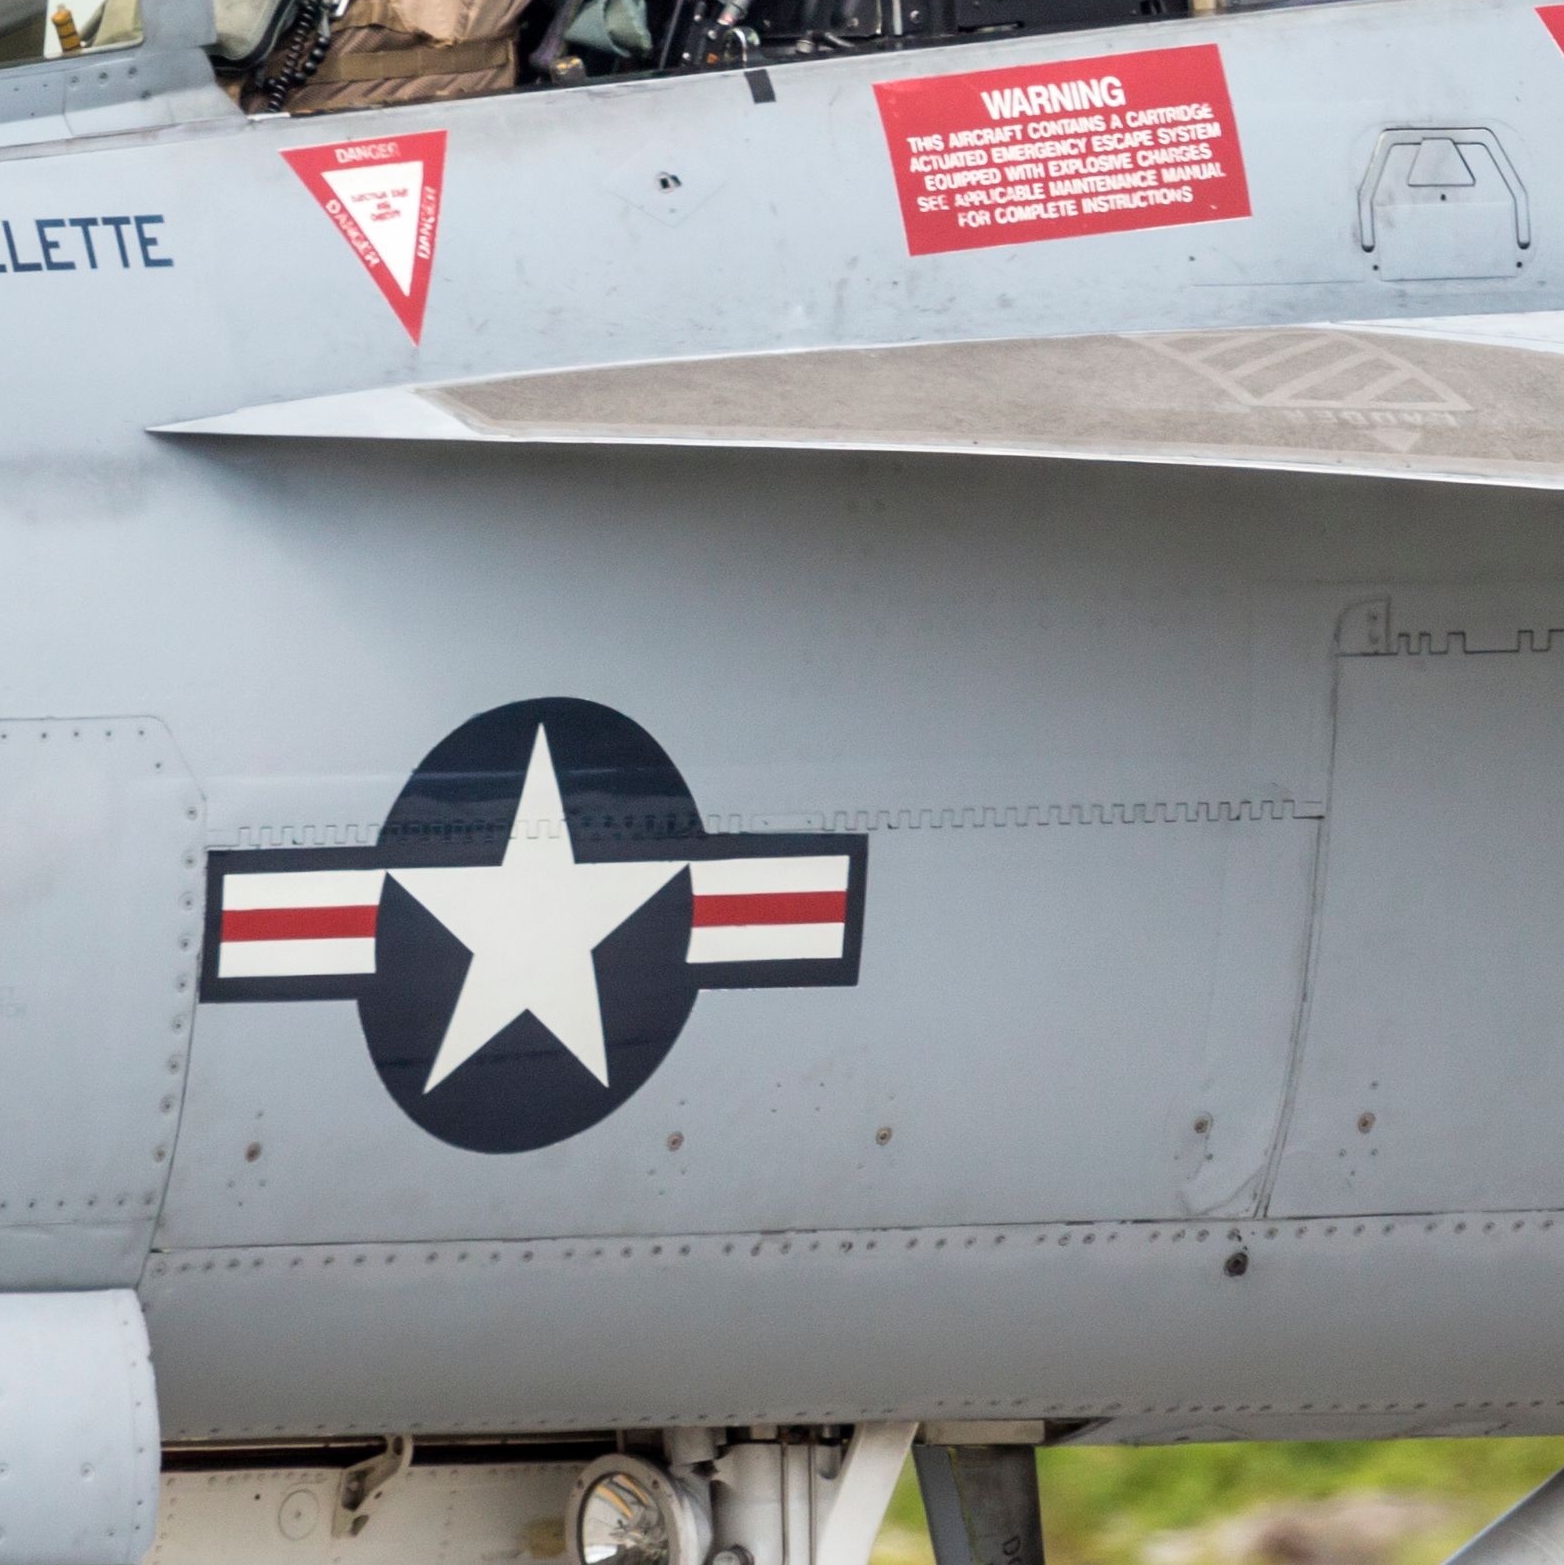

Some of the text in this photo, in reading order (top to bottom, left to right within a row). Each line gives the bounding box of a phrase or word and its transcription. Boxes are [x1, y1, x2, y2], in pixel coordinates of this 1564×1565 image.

[981, 75, 1127, 120] WARNING
[335, 141, 401, 164] DANGER
[907, 103, 1215, 153] THIS AIRCRAFT CONTAINS A CARTRIDGE
[910, 122, 1222, 173] ACTUATED EMERGENCY ESCAPE SYSTEM
[917, 161, 1226, 212] SEE APPLICABLE MAINTENANCE MANUAL
[924, 142, 1213, 192] EQUIPPED WITH EXPLOSIVE CHARGES
[958, 186, 1194, 228] FOR COMPLETE INSTRUCTIONS
